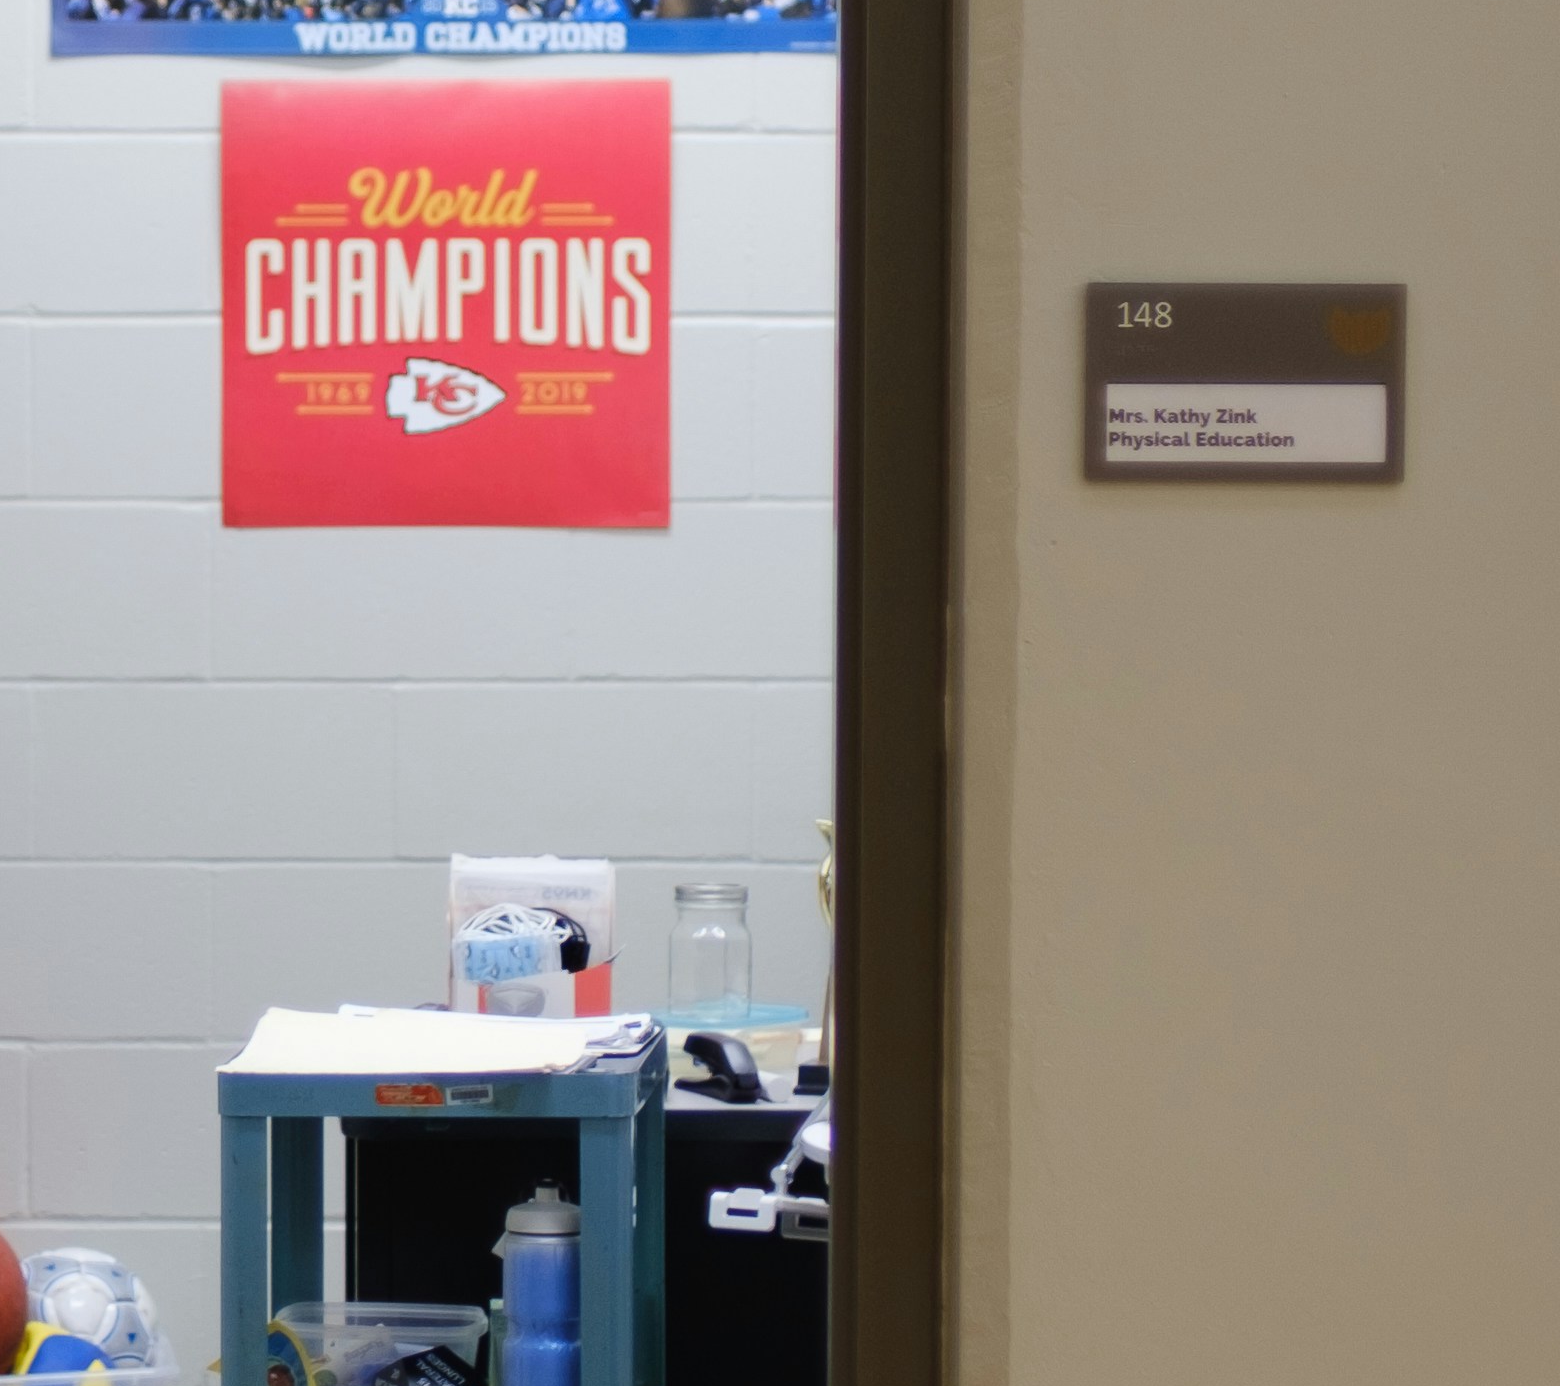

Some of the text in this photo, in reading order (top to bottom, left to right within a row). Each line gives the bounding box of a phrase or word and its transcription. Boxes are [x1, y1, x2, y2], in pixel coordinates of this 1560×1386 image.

[294, 22, 626, 52] WORLD CHAMPIONS
[349, 167, 538, 227] World
[245, 237, 651, 355] CHAMPIONS
[1117, 301, 1173, 328] 148
[307, 375, 588, 415] 1969 KC 2019
[1109, 409, 1257, 428] Mrs. Kathy Zink
[1109, 432, 1294, 450] Physical Education
